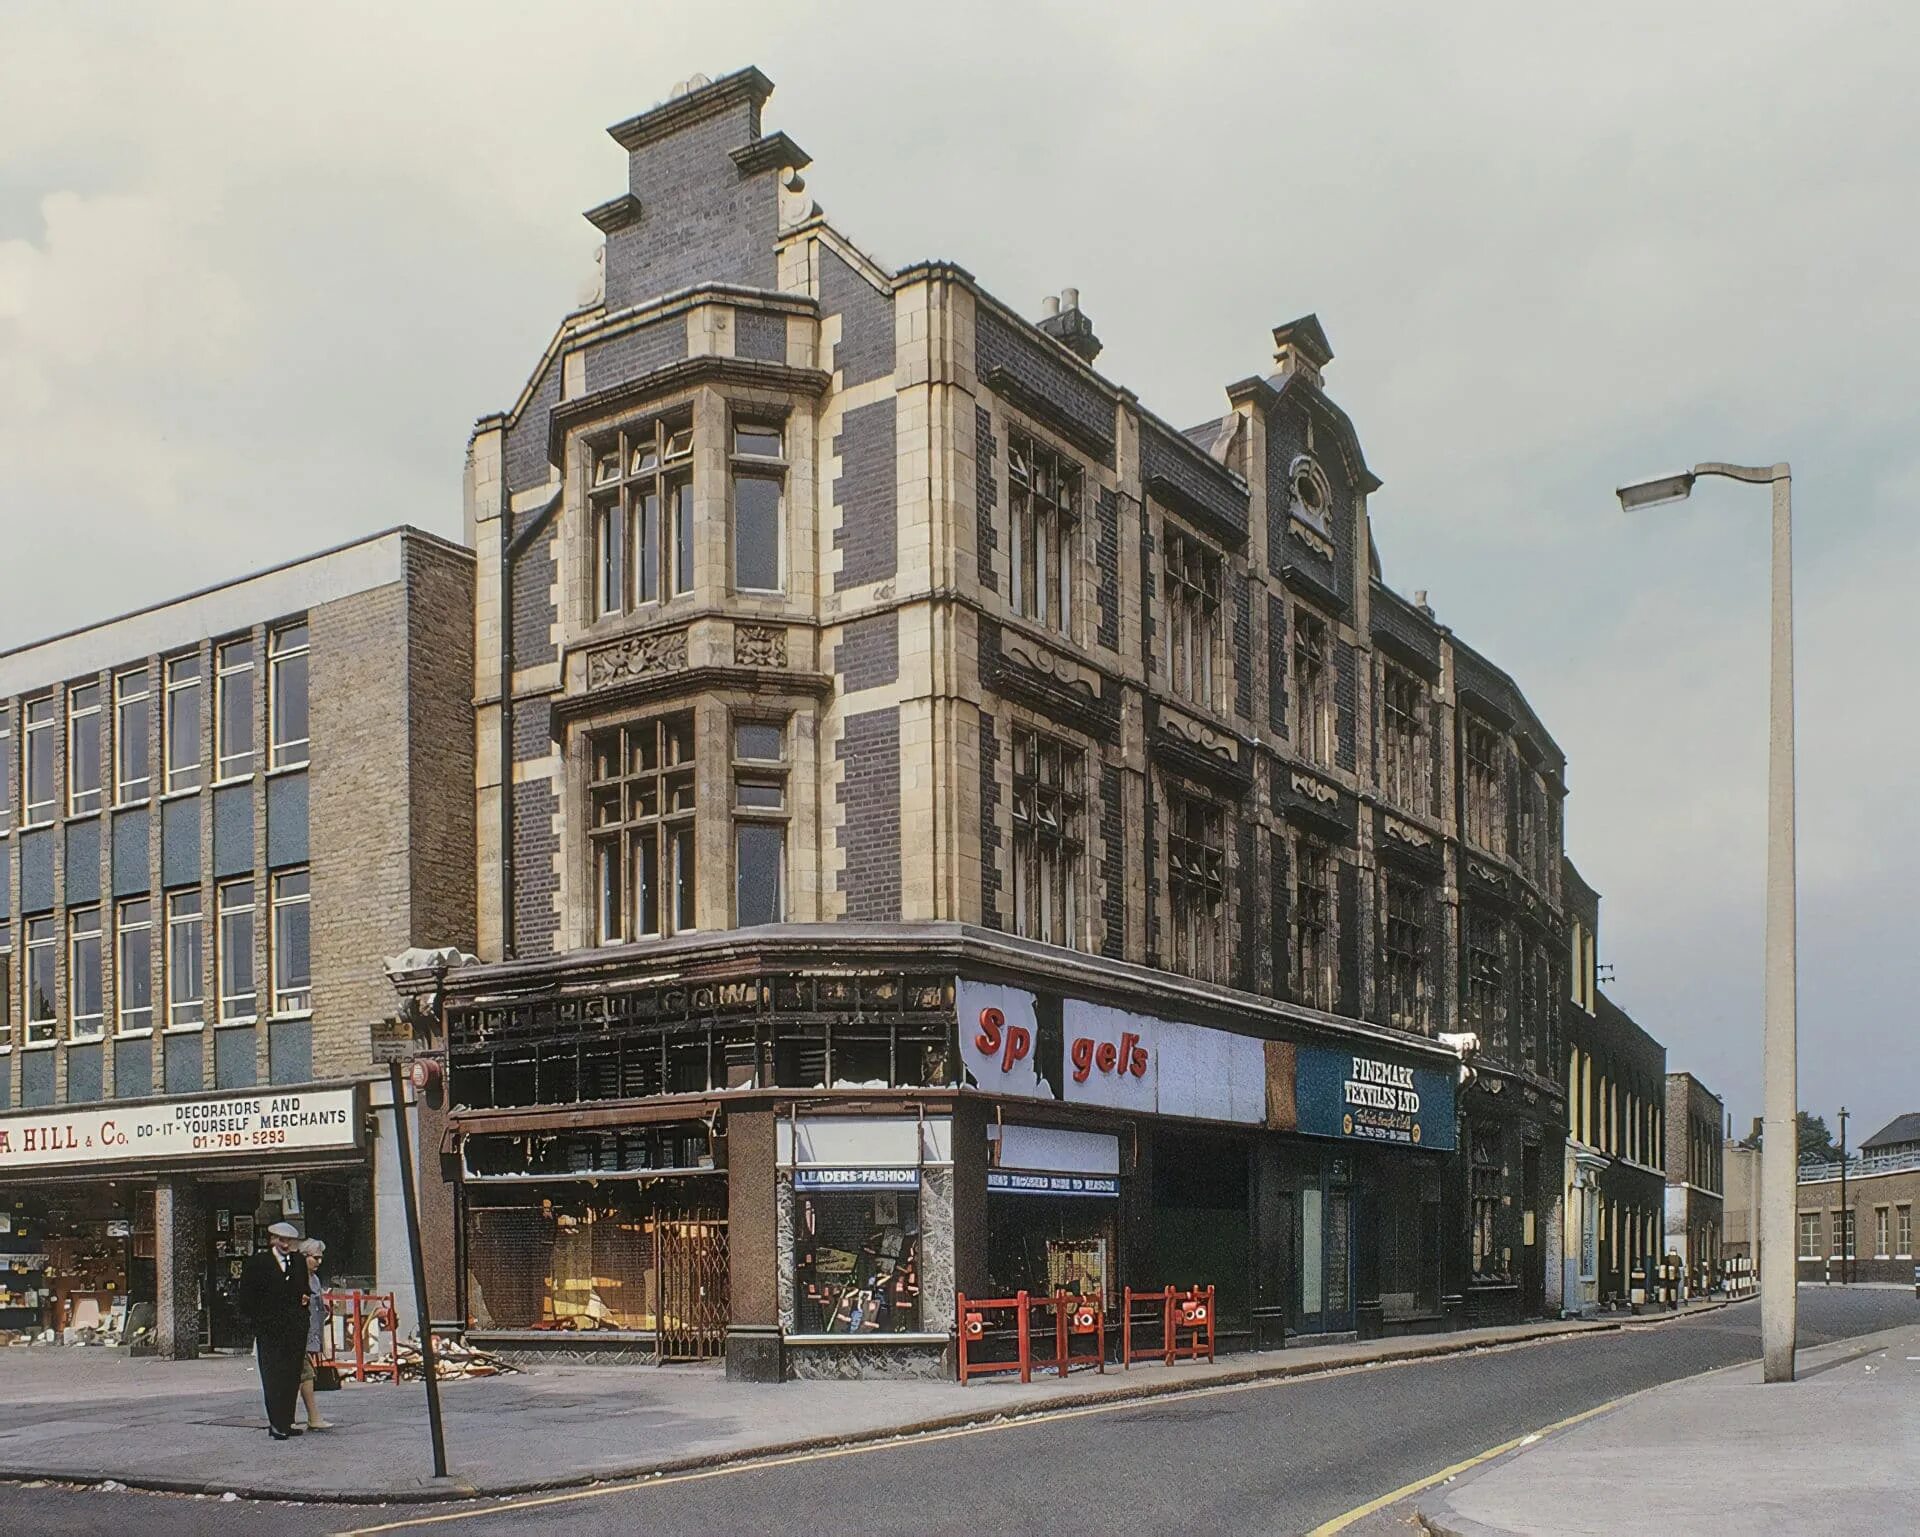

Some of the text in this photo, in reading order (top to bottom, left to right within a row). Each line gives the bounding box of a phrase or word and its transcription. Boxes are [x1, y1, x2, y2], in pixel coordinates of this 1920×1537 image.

[176, 1097, 300, 1120] DECORATORS AND
[1344, 1081, 1420, 1113] TEXTILES LTD
[260, 1110, 346, 1128] MERCHANTS
[24, 1125, 78, 1151] HILL
